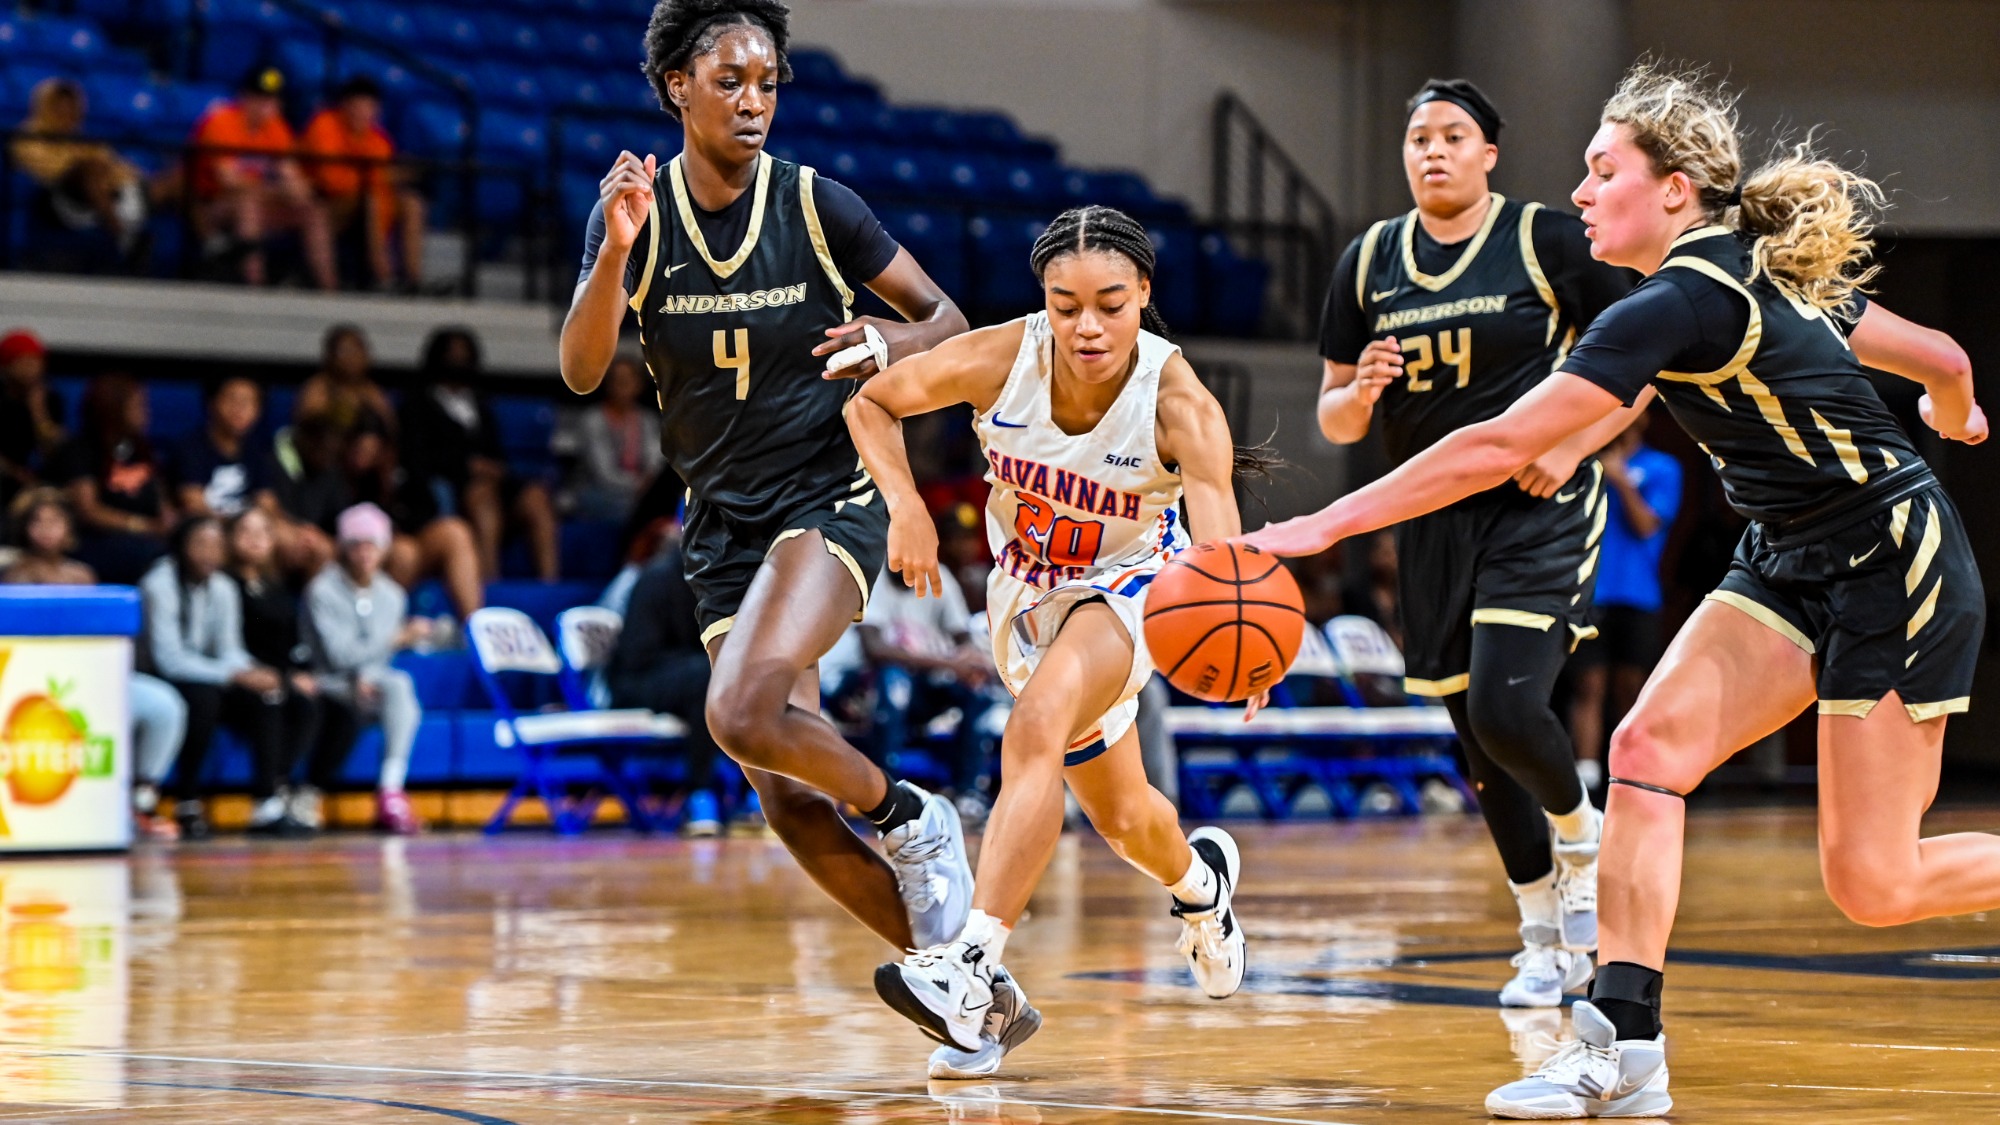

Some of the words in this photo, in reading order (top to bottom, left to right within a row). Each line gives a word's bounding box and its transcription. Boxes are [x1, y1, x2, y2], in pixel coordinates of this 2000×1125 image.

[658, 282, 807, 314] ANDERSON
[1375, 294, 1508, 333] ANDERSON
[712, 328, 750, 400] 4
[1400, 327, 1472, 393] 24
[988, 448, 1142, 522] SAVANNAH
[1103, 453, 1142, 468] SIAC
[1014, 490, 1105, 567] 20
[0, 738, 108, 775] OTTERY
